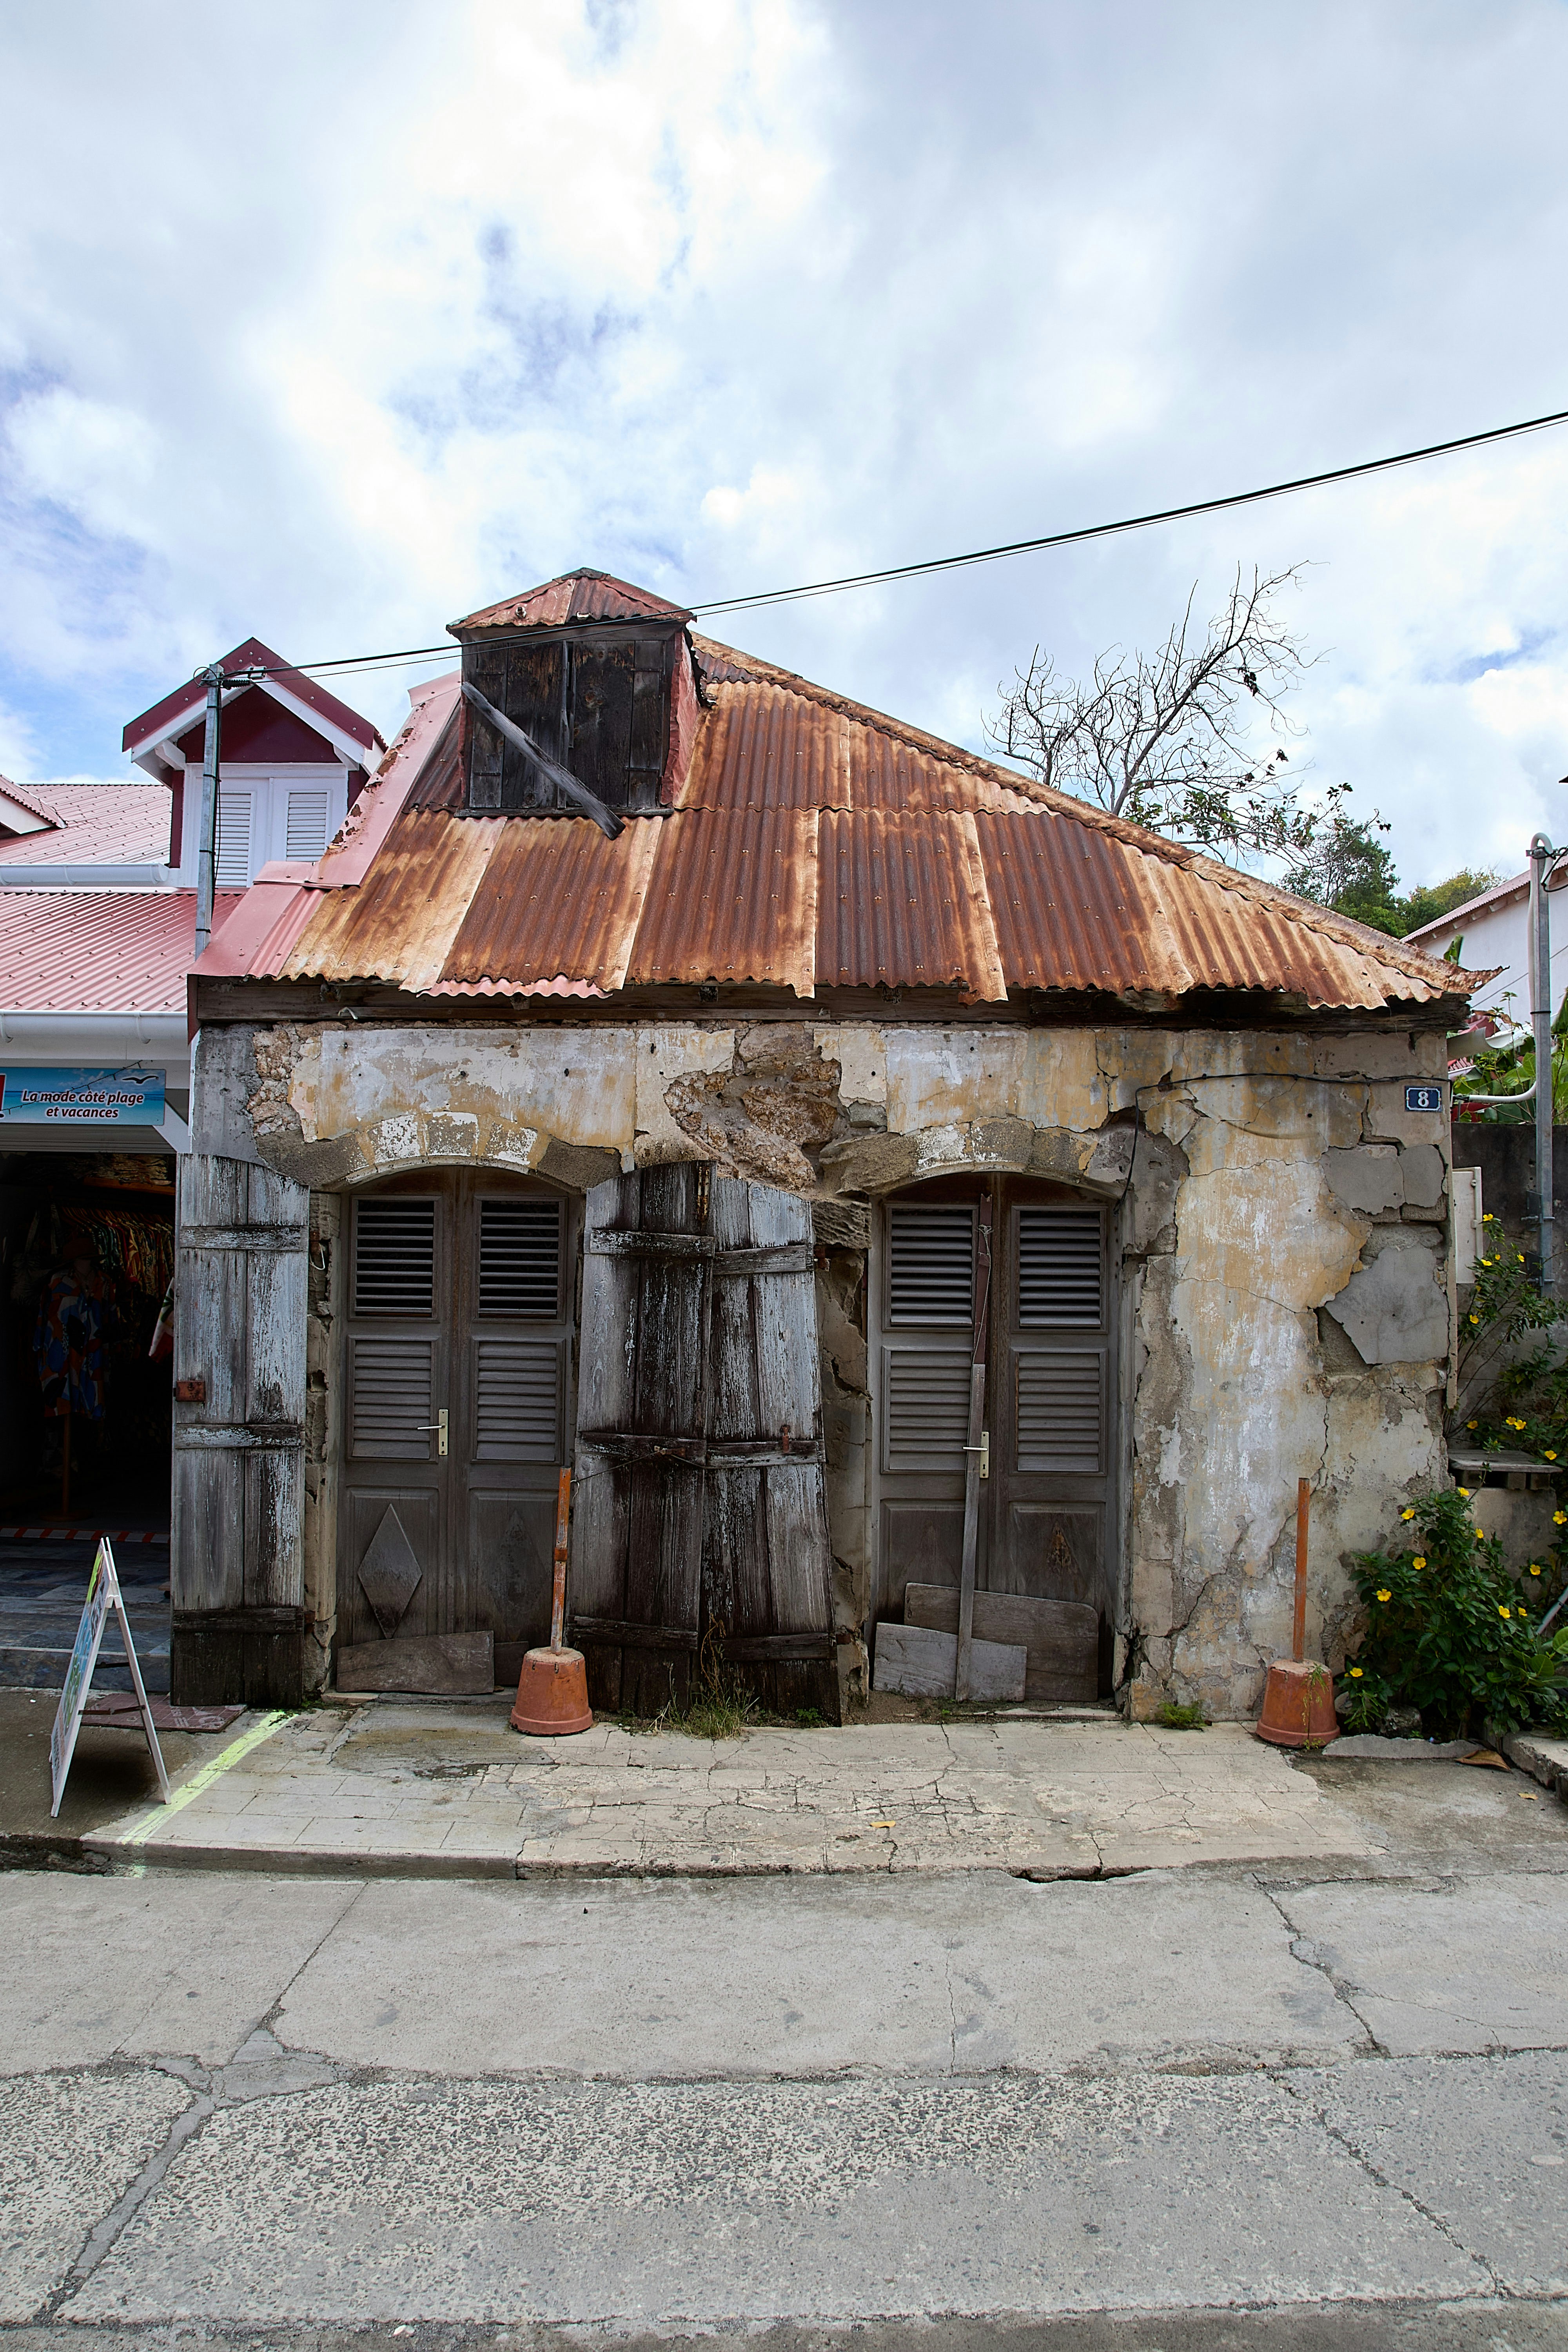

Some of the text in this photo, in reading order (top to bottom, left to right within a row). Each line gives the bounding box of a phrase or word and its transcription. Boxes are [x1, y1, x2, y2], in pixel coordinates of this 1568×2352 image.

[22, 1090, 144, 1106] La mode côté plage
[1418, 1091, 1429, 1107] 8
[46, 1107, 118, 1118] et vacances
